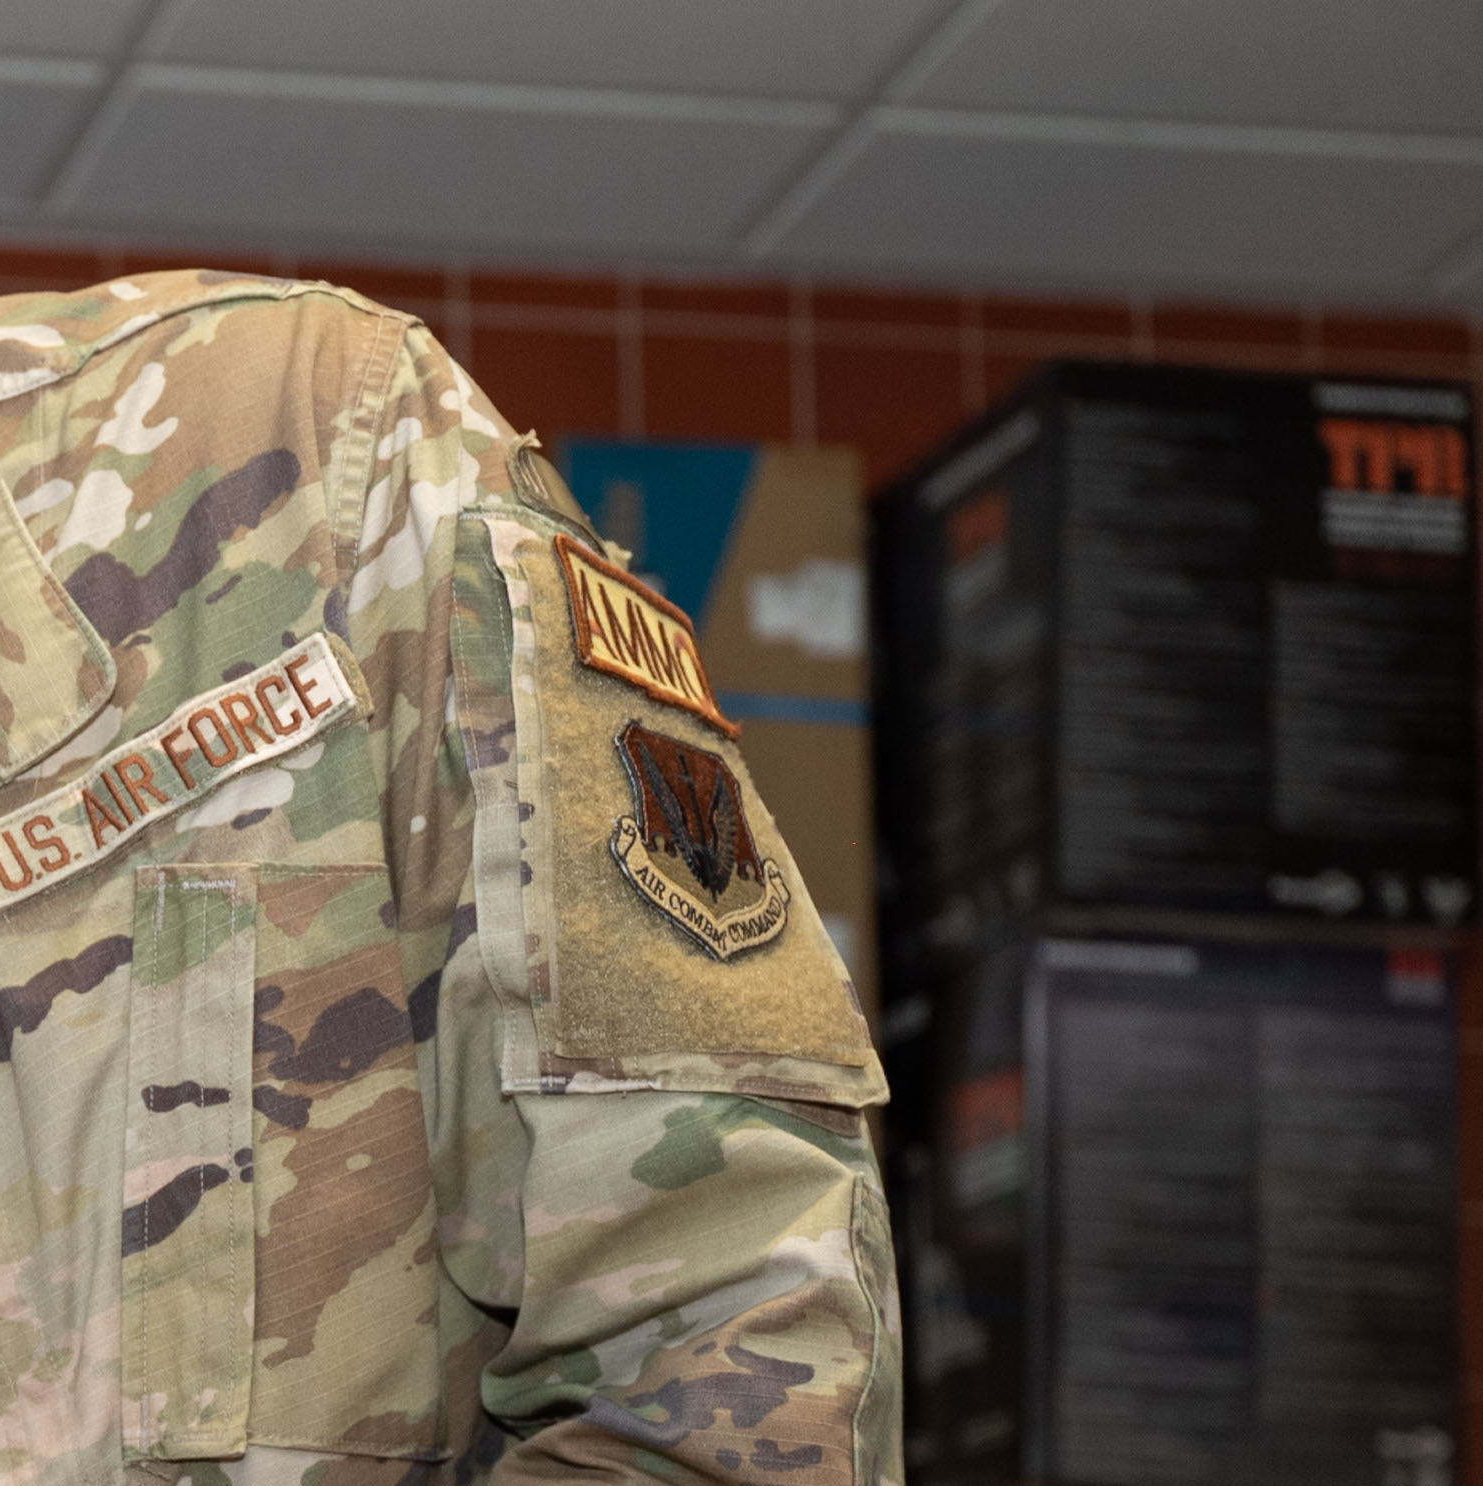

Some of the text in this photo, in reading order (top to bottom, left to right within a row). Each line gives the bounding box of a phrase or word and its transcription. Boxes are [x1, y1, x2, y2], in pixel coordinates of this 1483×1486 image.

[80, 753, 171, 849] AIR
[159, 654, 333, 791] FORCE
[635, 865, 783, 951] AIR COMBAT COMMAND
